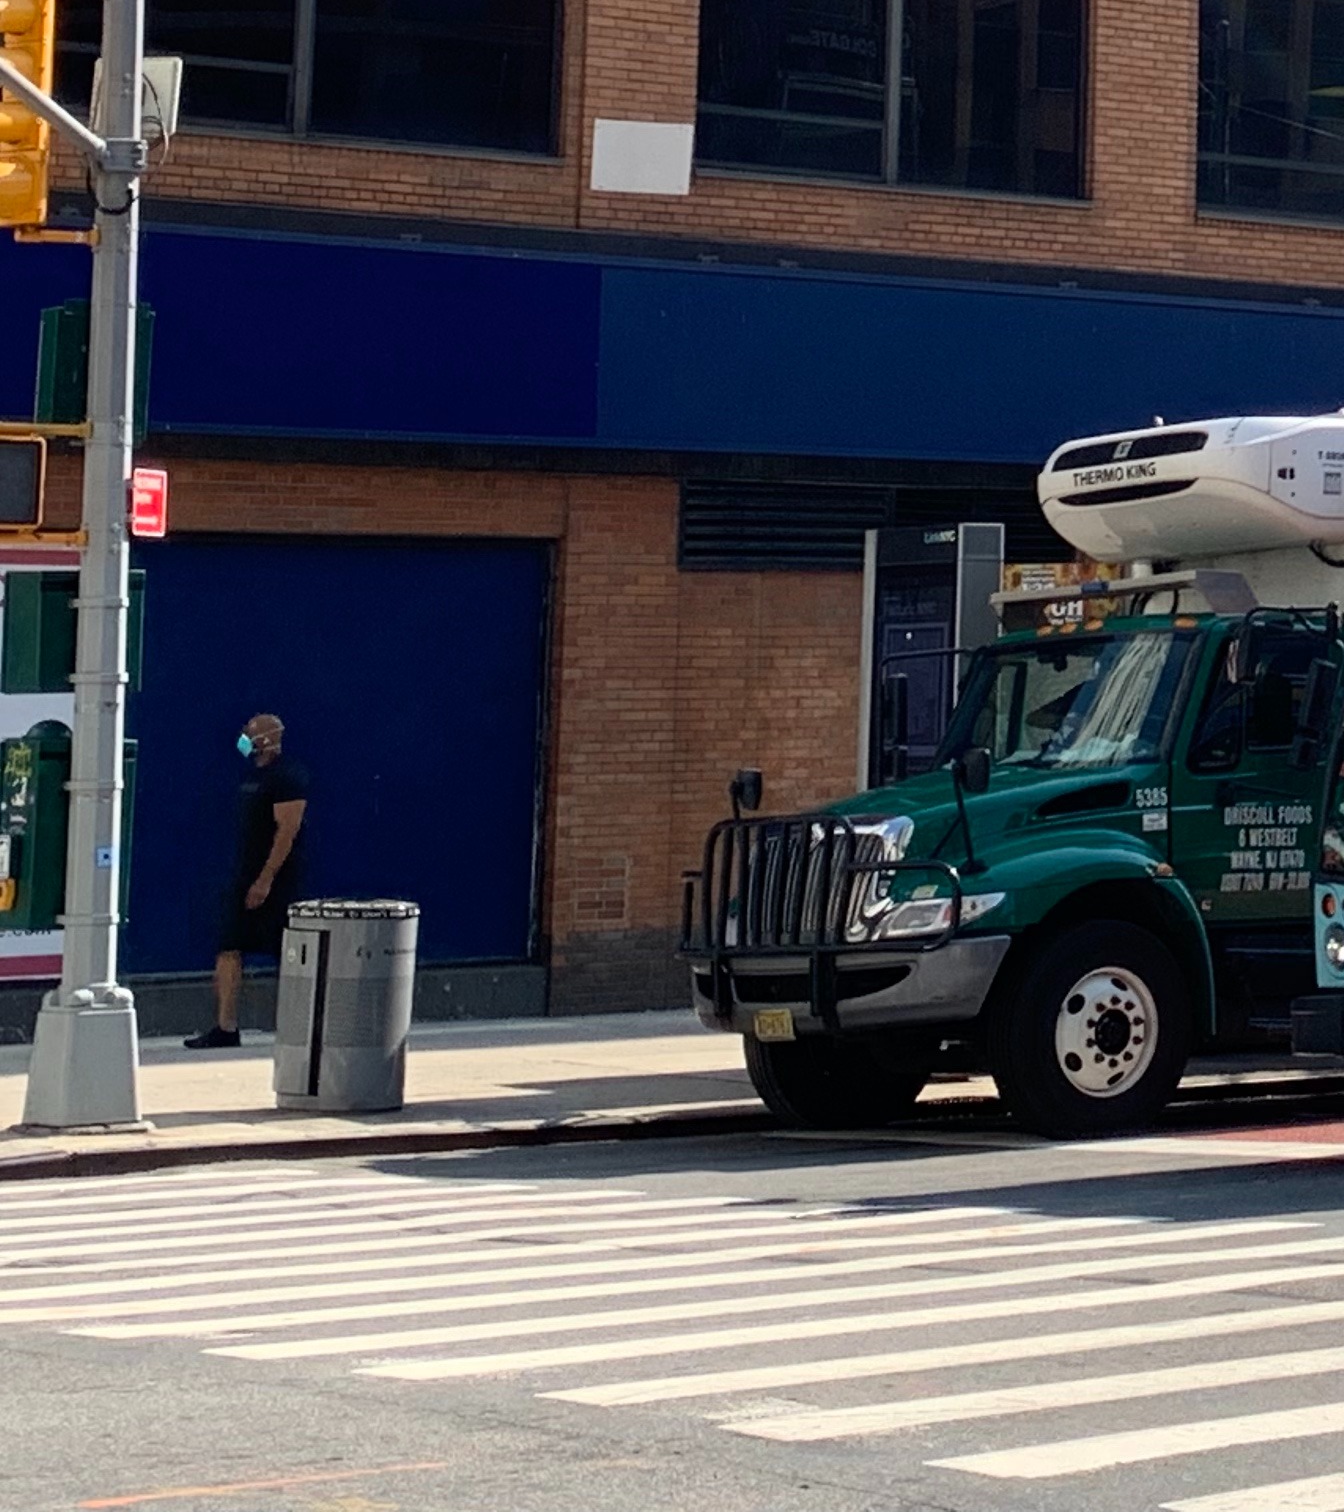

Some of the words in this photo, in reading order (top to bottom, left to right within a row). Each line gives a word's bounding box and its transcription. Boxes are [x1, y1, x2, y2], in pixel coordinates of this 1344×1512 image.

[1072, 467, 1126, 487] THERMO
[1126, 462, 1157, 480] KING
[1135, 787, 1168, 808] 5385
[1223, 805, 1276, 826] DRISCOLL
[1277, 804, 1314, 825] FOODS
